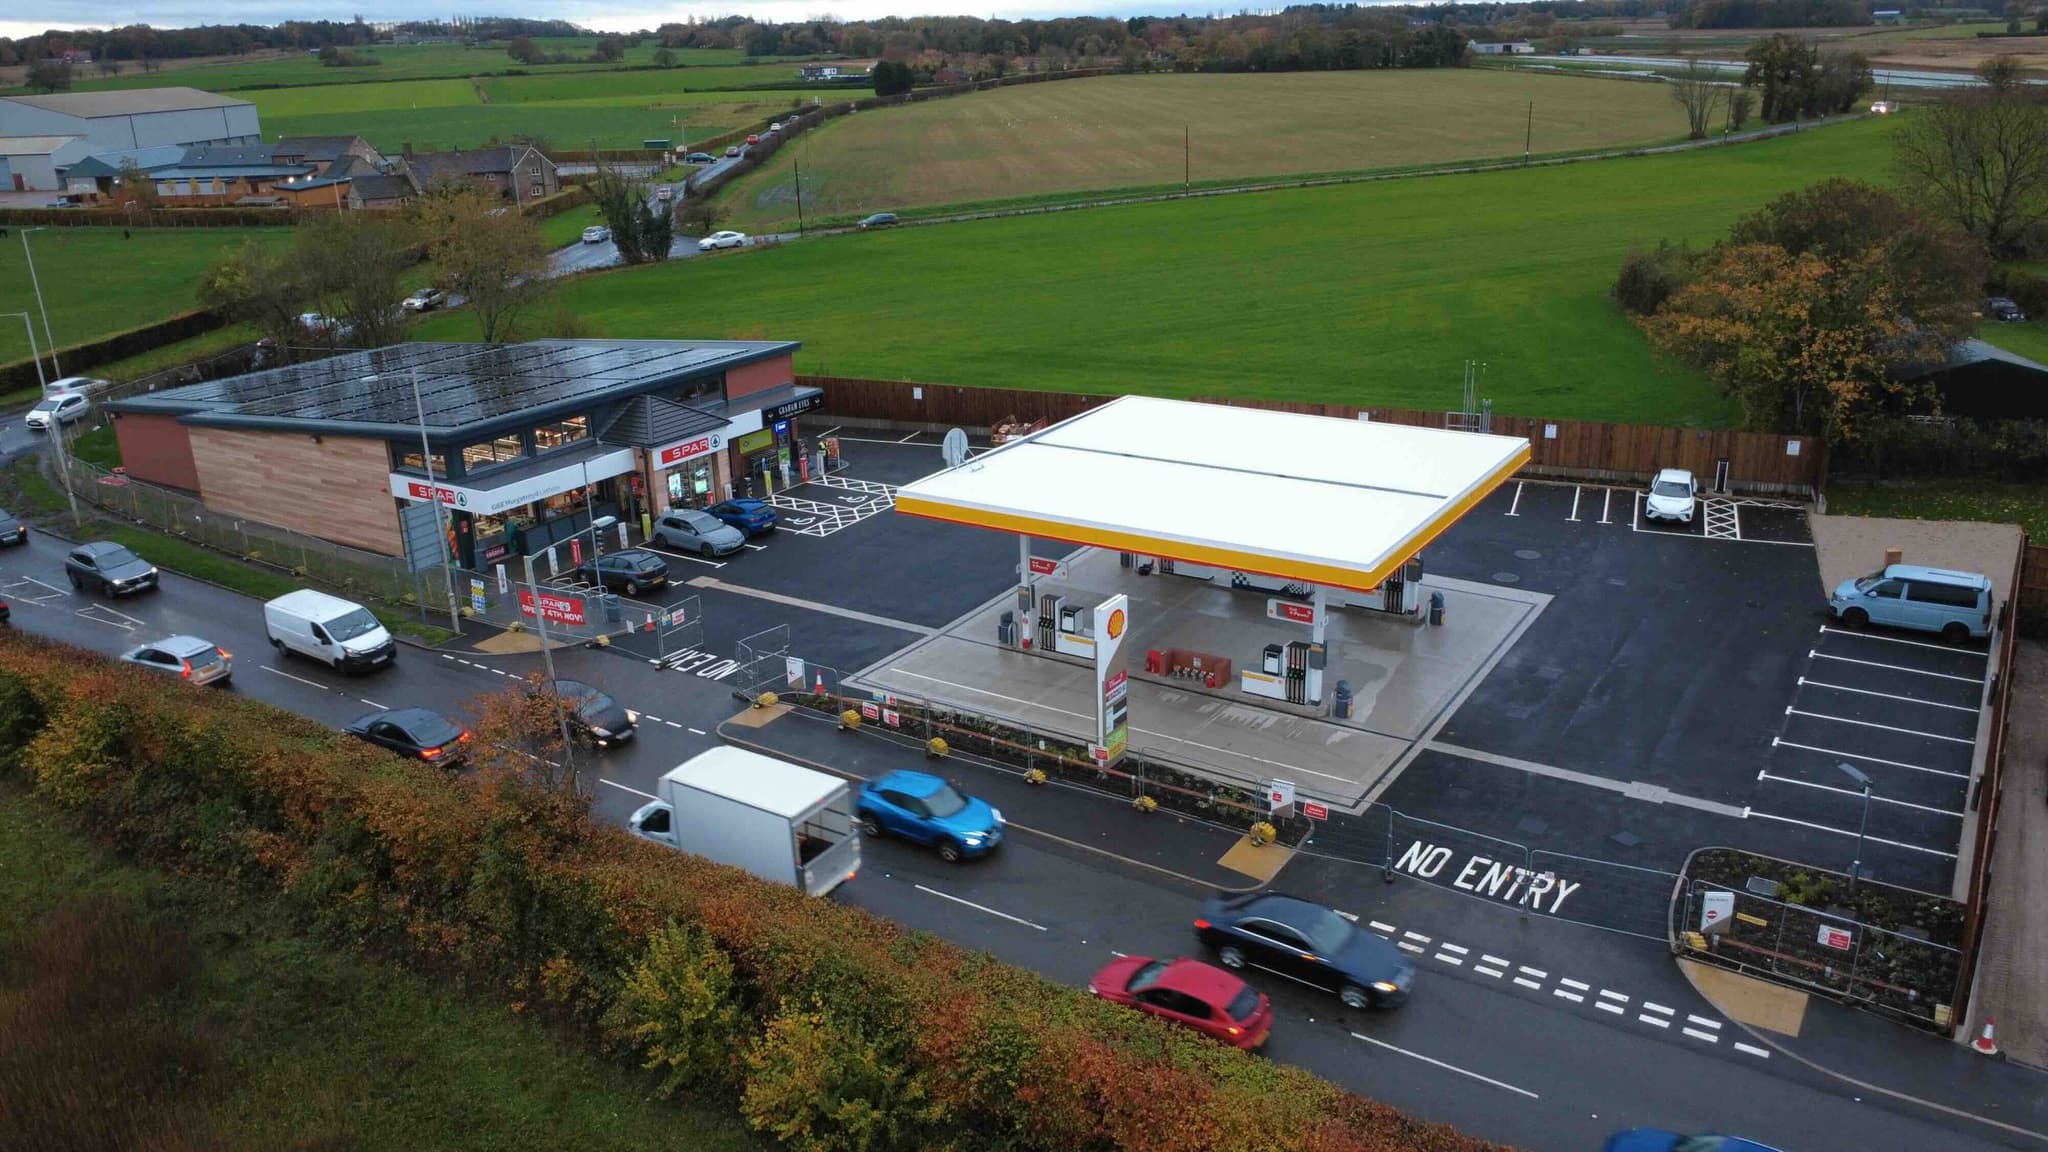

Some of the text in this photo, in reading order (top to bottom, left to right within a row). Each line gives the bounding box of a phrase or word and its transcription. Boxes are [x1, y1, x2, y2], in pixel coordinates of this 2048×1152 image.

[672, 440, 708, 459] SPAR
[522, 604, 546, 616] OPES
[696, 660, 738, 680] NO
[1394, 839, 1581, 914] NO ENTRY
